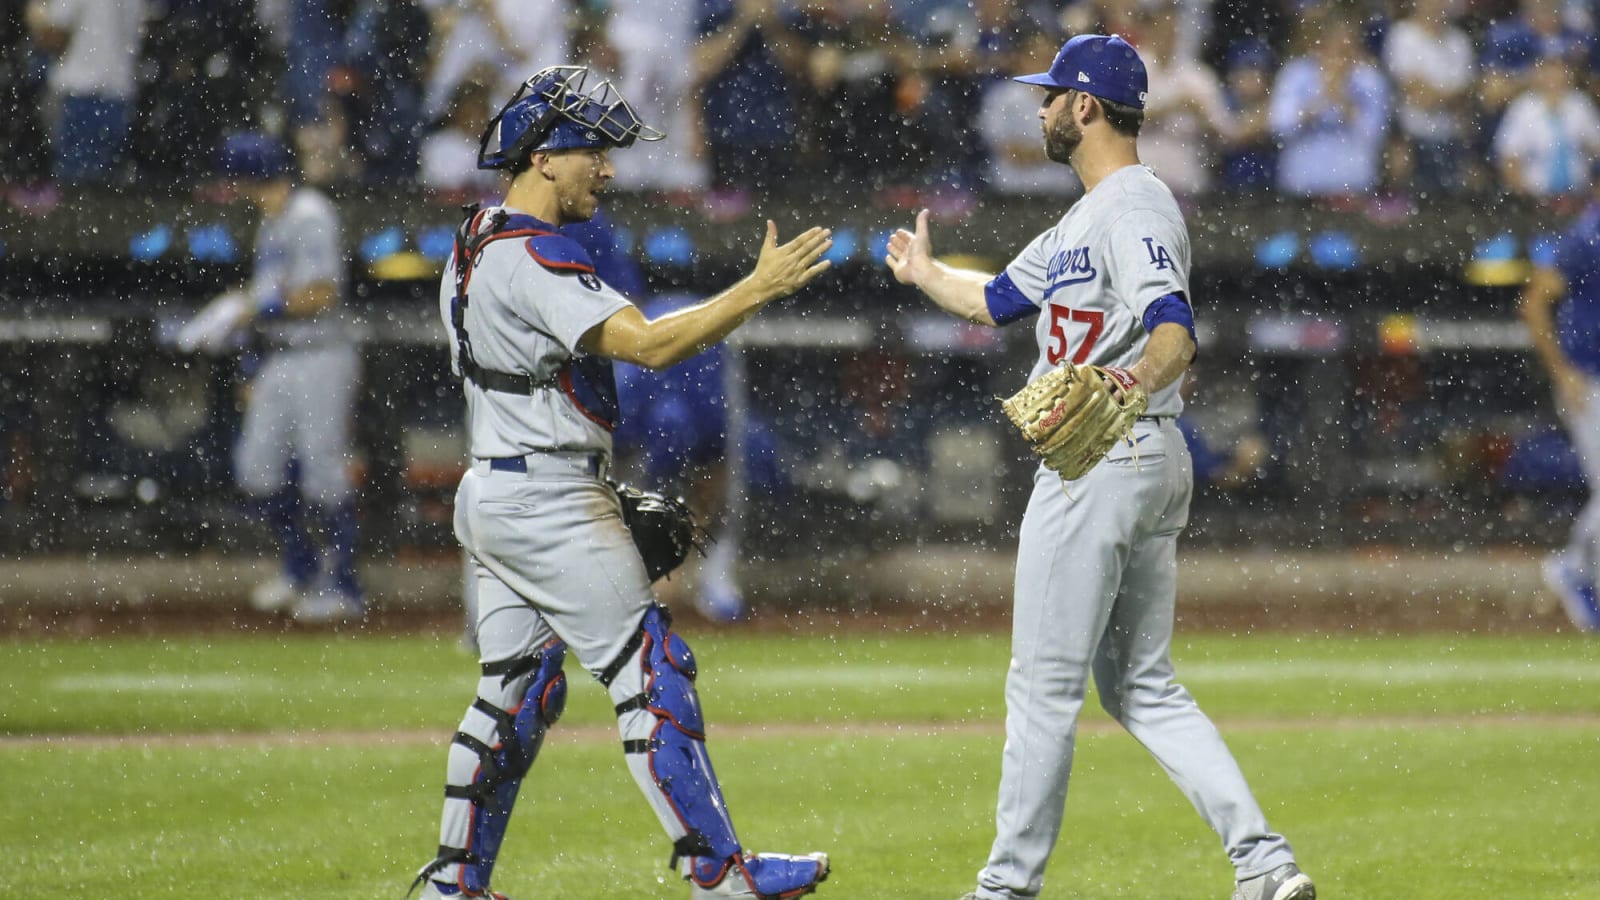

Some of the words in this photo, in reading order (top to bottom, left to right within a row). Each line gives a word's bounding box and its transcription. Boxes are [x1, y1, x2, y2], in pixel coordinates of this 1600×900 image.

[1045, 246, 1096, 297] gers
[1142, 237, 1177, 272] LA
[1047, 304, 1104, 367] 57
